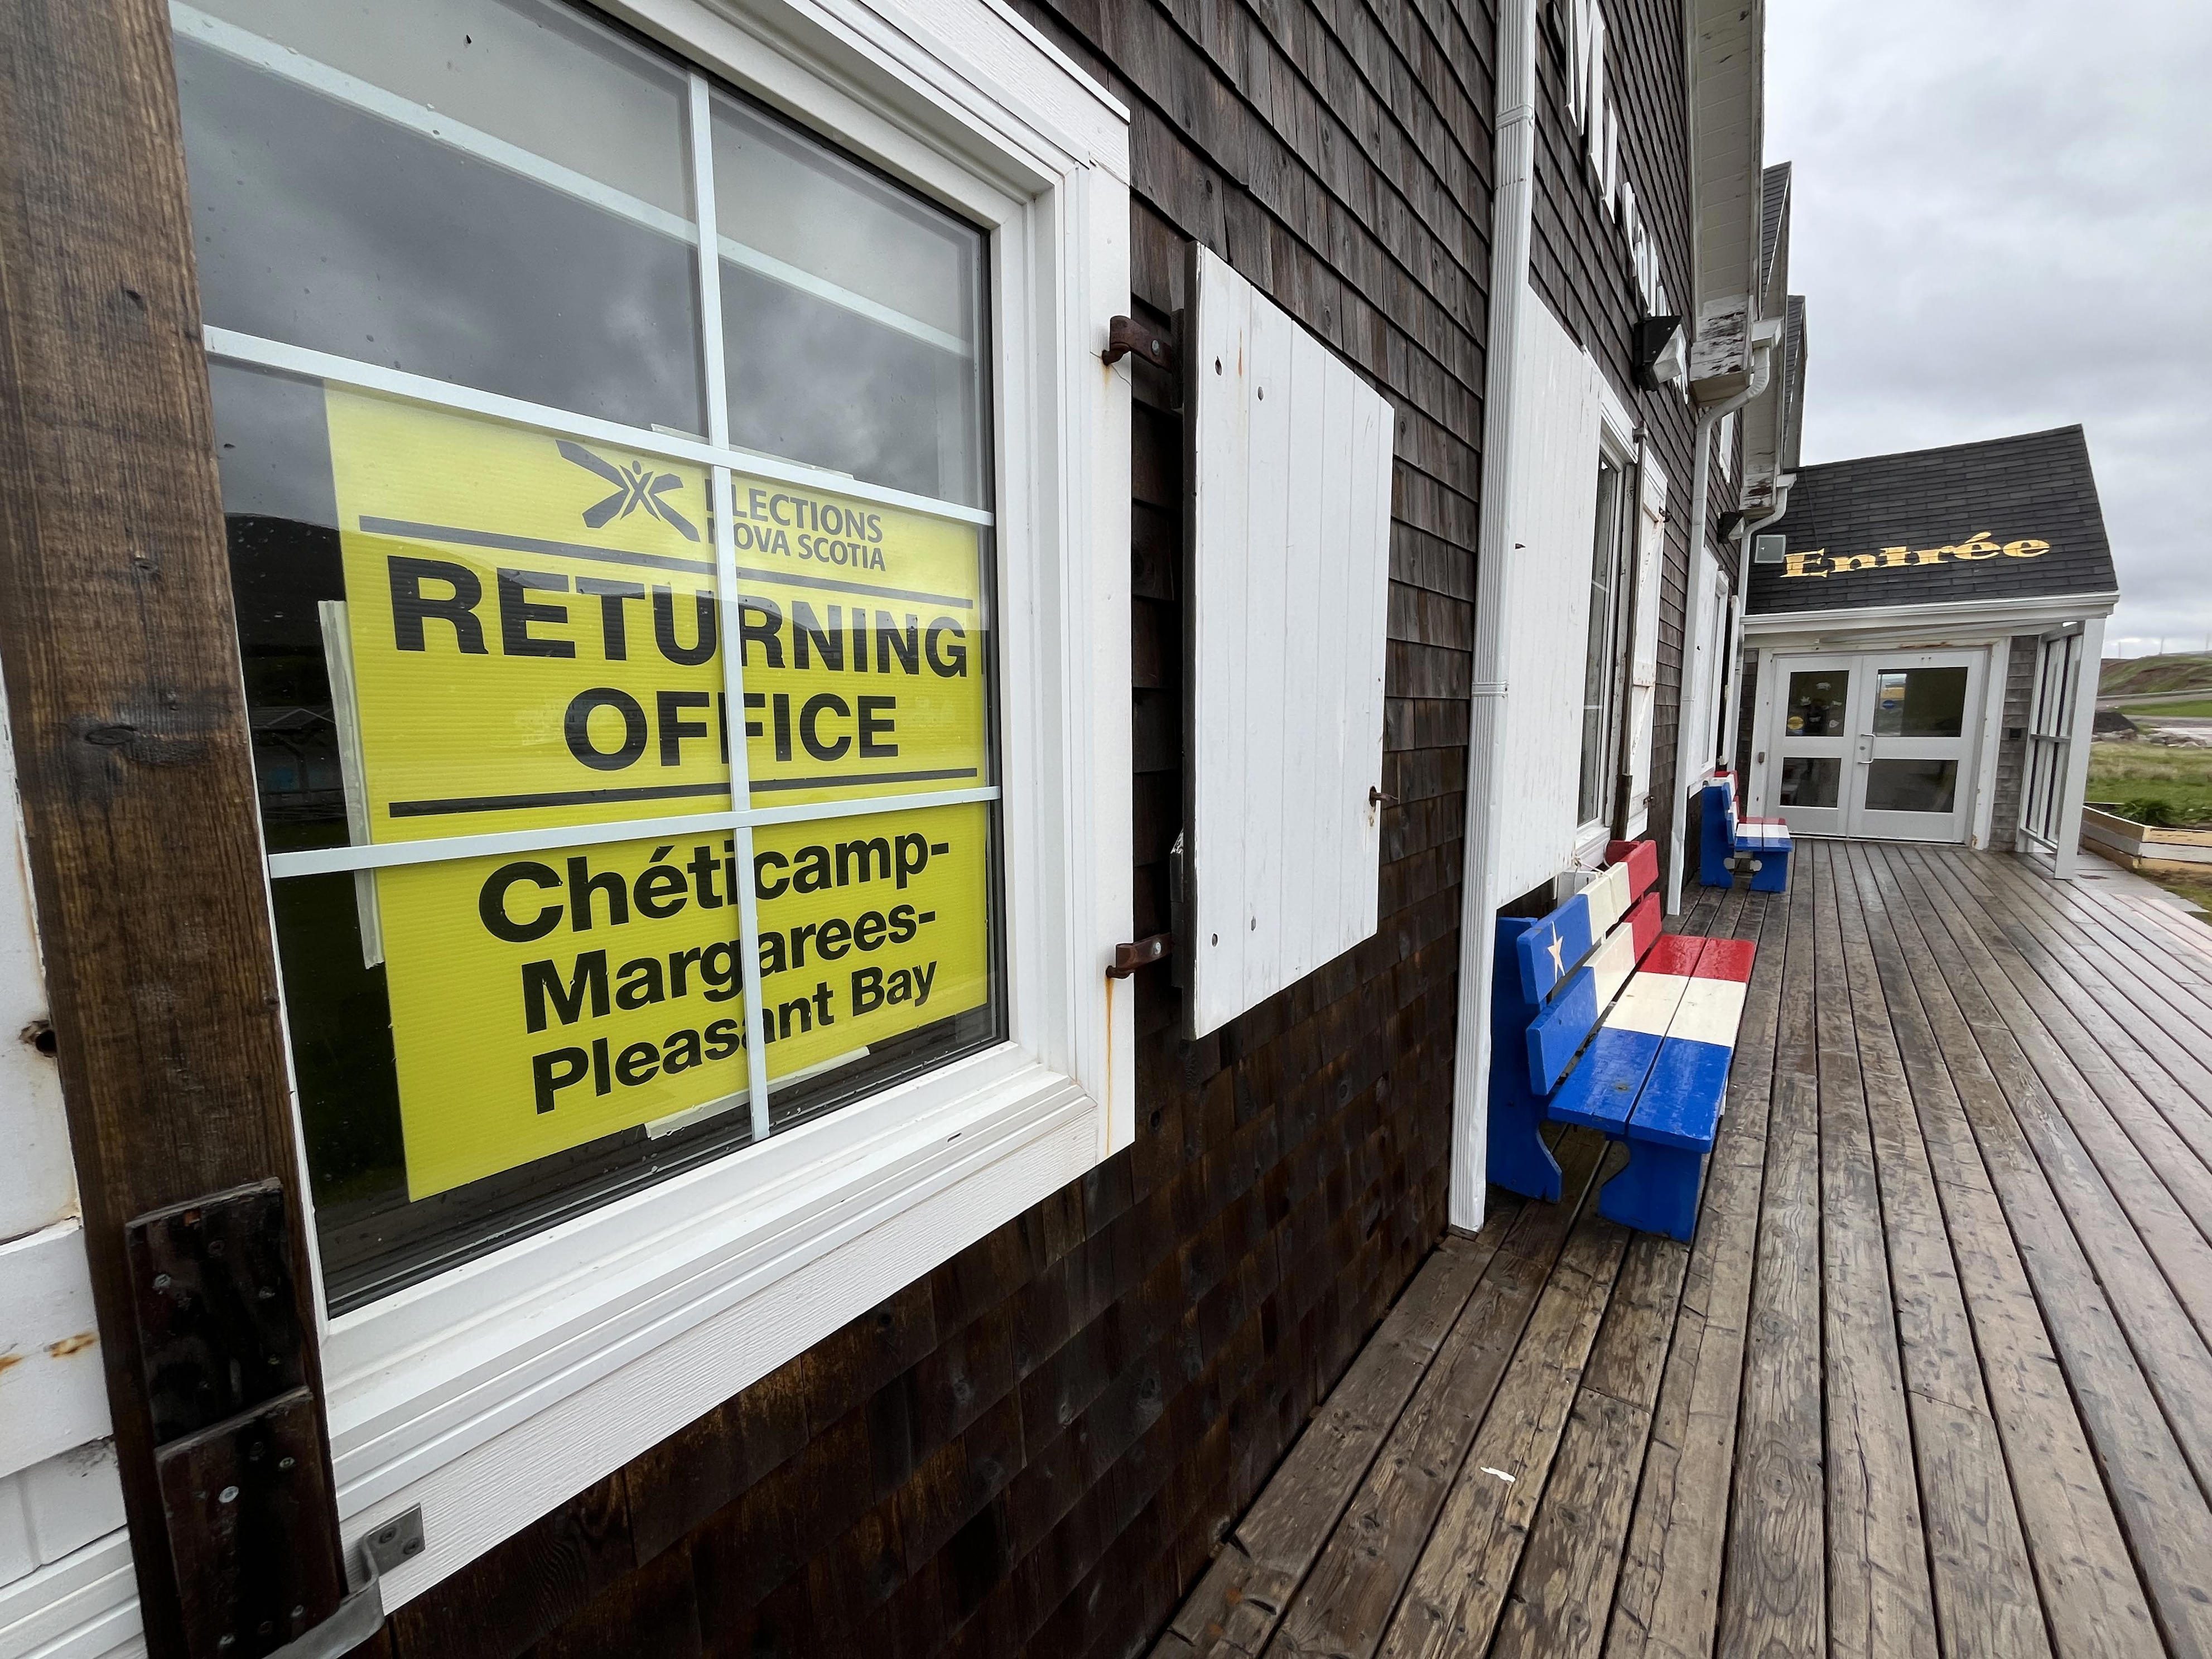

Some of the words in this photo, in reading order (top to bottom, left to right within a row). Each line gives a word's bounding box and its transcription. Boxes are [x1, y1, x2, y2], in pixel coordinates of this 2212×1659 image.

[797, 533, 886, 572] SCOTIA
[1779, 531, 2050, 578] Entrée
[386, 555, 968, 678] RETURNING
[563, 687, 899, 771] OFFICE
[479, 832, 949, 943] Chéticamp-
[521, 904, 936, 1034] Margarees-
[851, 961, 938, 1017] Bay
